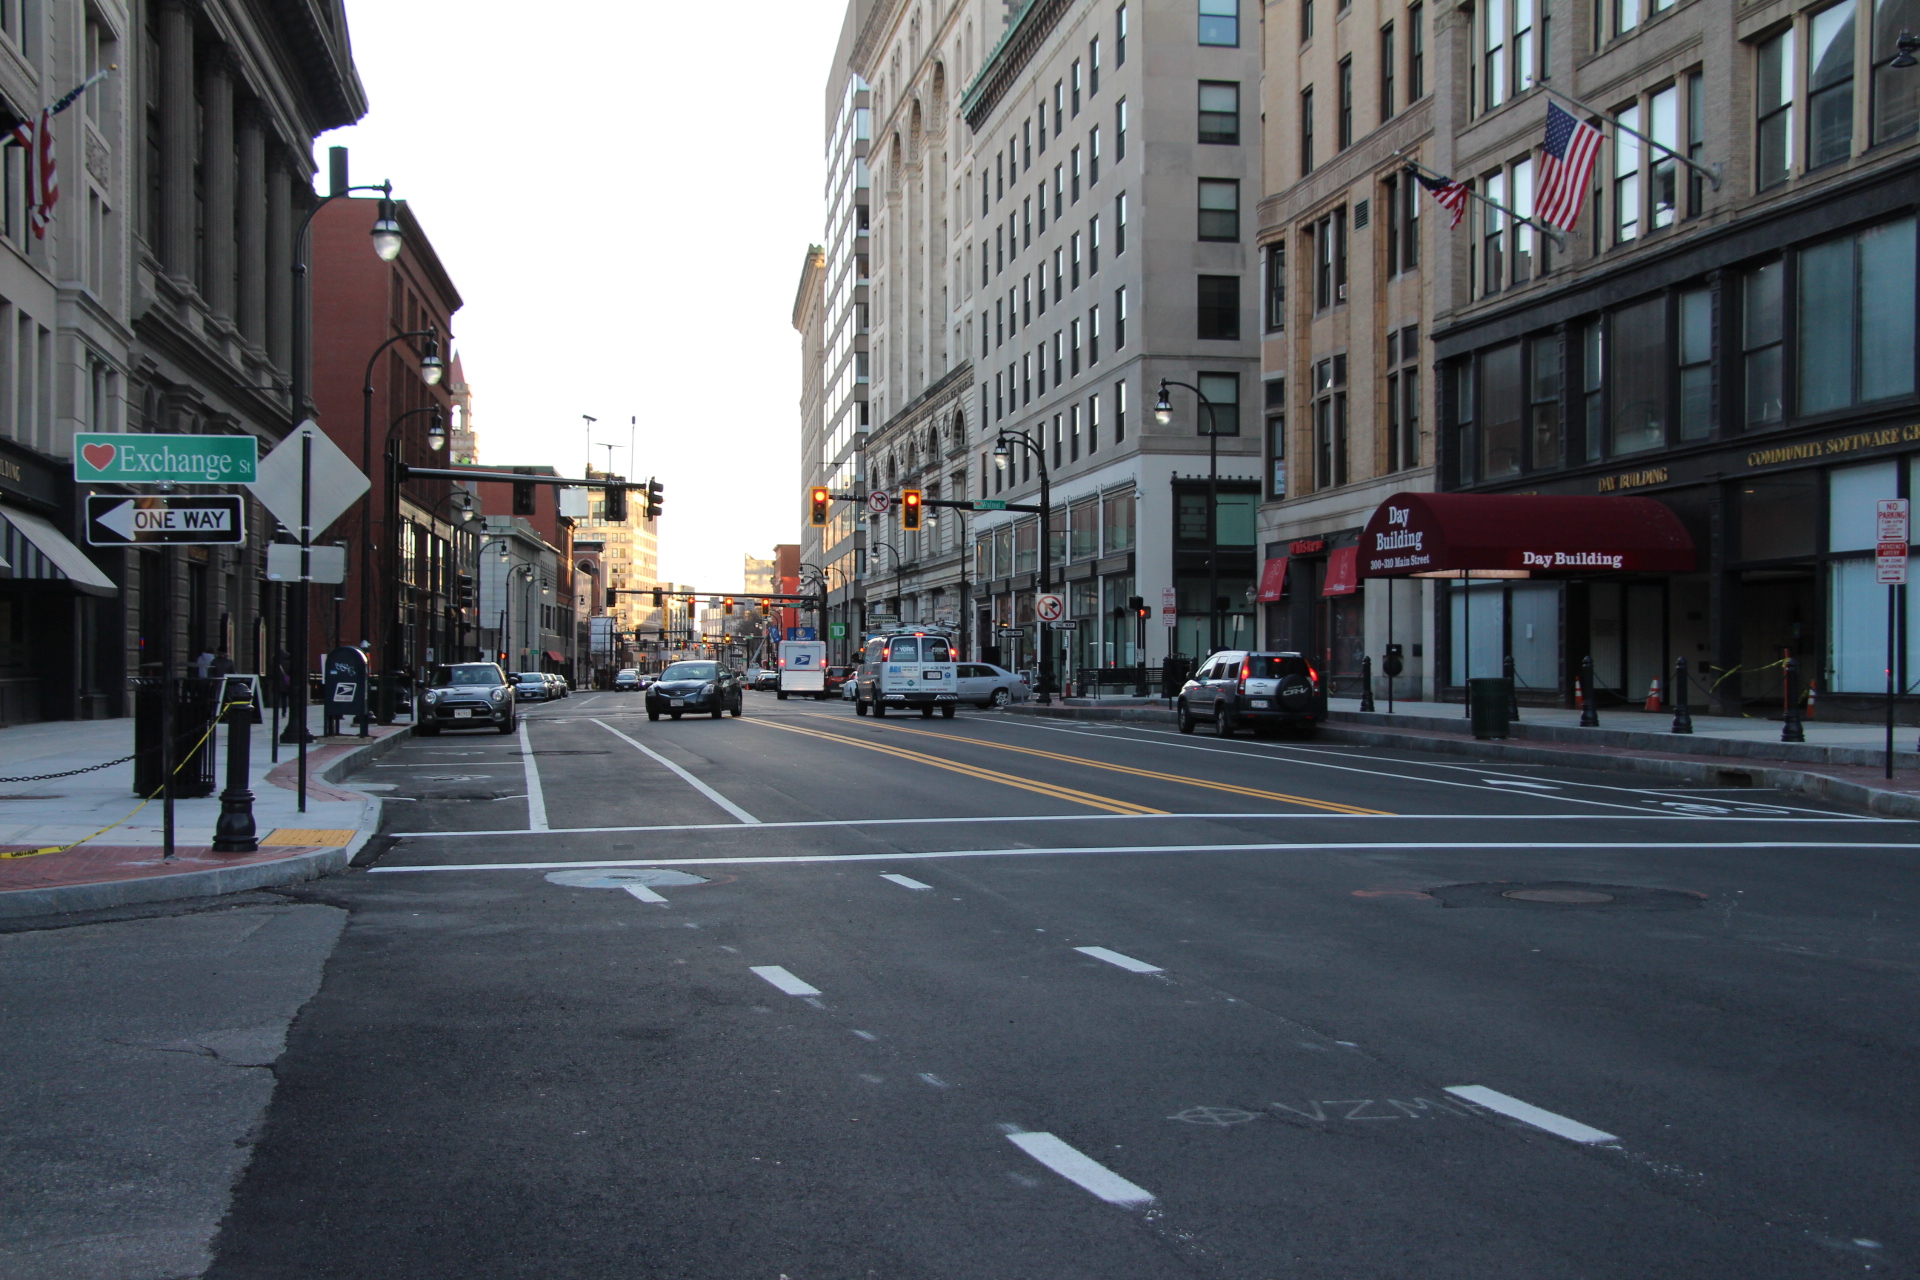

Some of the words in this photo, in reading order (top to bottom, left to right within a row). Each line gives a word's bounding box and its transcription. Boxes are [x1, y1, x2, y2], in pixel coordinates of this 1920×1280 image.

[1747, 440, 1824, 467] COMMUNITY
[1825, 427, 1900, 454] SOFTWARE
[118, 445, 232, 481] Exchange
[239, 459, 252, 474] St
[1598, 475, 1617, 492] DAY
[1619, 467, 1668, 489] BUILDING
[981, 500, 1001, 509] Walnut
[1886, 502, 1898, 511] NO
[135, 511, 176, 529] ONE
[183, 511, 225, 529] WAY
[1388, 506, 1409, 528] Day
[1878, 511, 1906, 519] PARKING
[1376, 529, 1423, 551] Building
[1370, 558, 1394, 570] 300-310
[1394, 556, 1410, 568] Main
[1410, 553, 1430, 566] Street
[1523, 551, 1553, 568] Day
[1554, 551, 1623, 568] Building
[830, 625, 845, 637] TD
